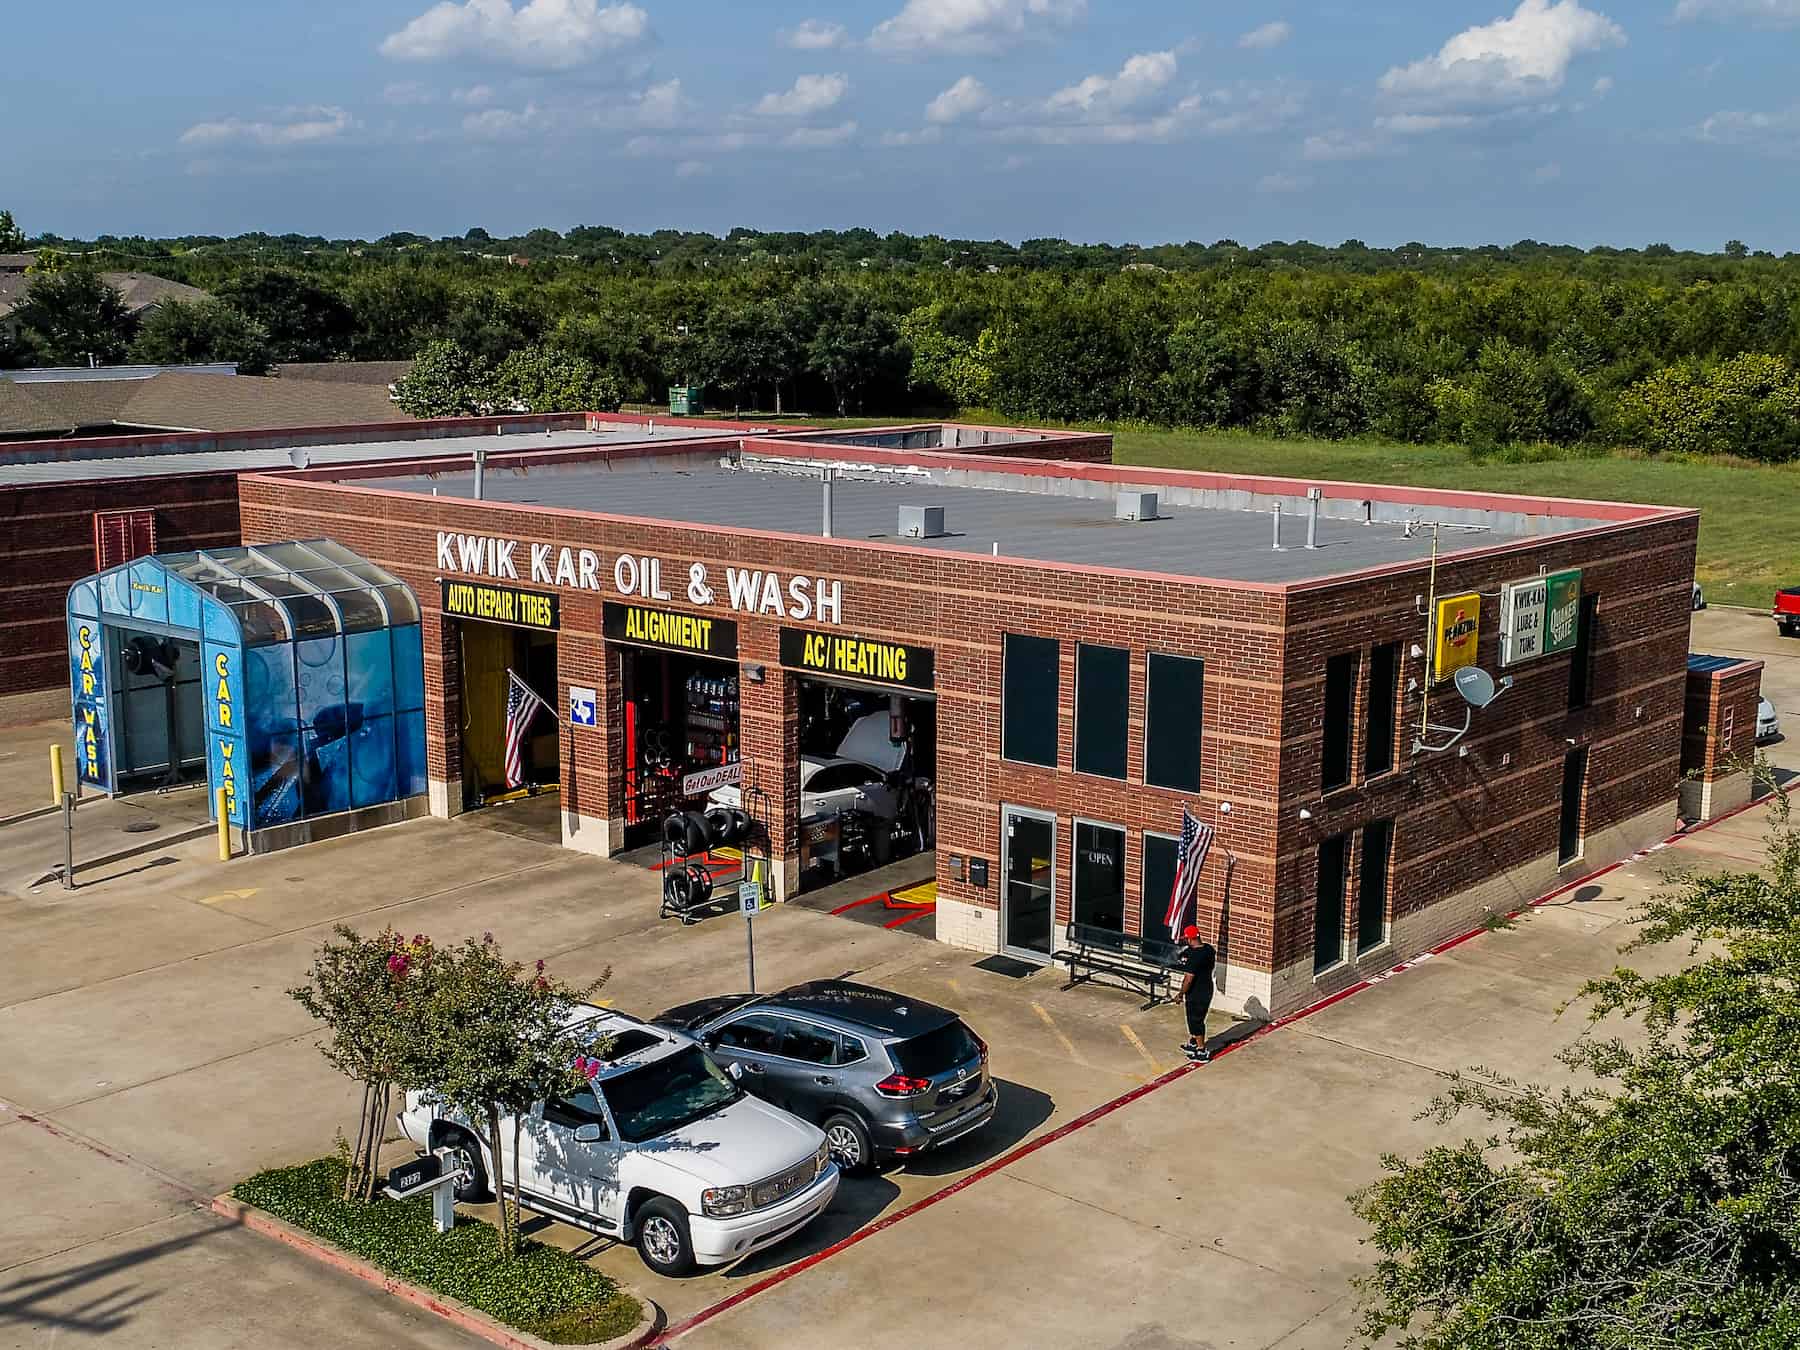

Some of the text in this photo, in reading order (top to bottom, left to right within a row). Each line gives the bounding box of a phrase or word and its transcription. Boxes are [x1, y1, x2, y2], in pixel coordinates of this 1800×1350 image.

[437, 532, 842, 625] KWIK KAR OIL & WASH
[448, 583, 475, 615] AUTO
[477, 587, 513, 621] REPAIR
[519, 594, 551, 626] TIRES
[1516, 614, 1533, 633] LUBE
[625, 608, 712, 651] ALIGNMENT
[1519, 635, 1536, 656] TUNE
[79, 626, 95, 695] CAR
[835, 638, 906, 680] HEATING
[215, 653, 232, 727] CAR
[83, 708, 99, 779] WASH
[219, 740, 237, 816] WASH
[1088, 850, 1113, 866] OPEN
